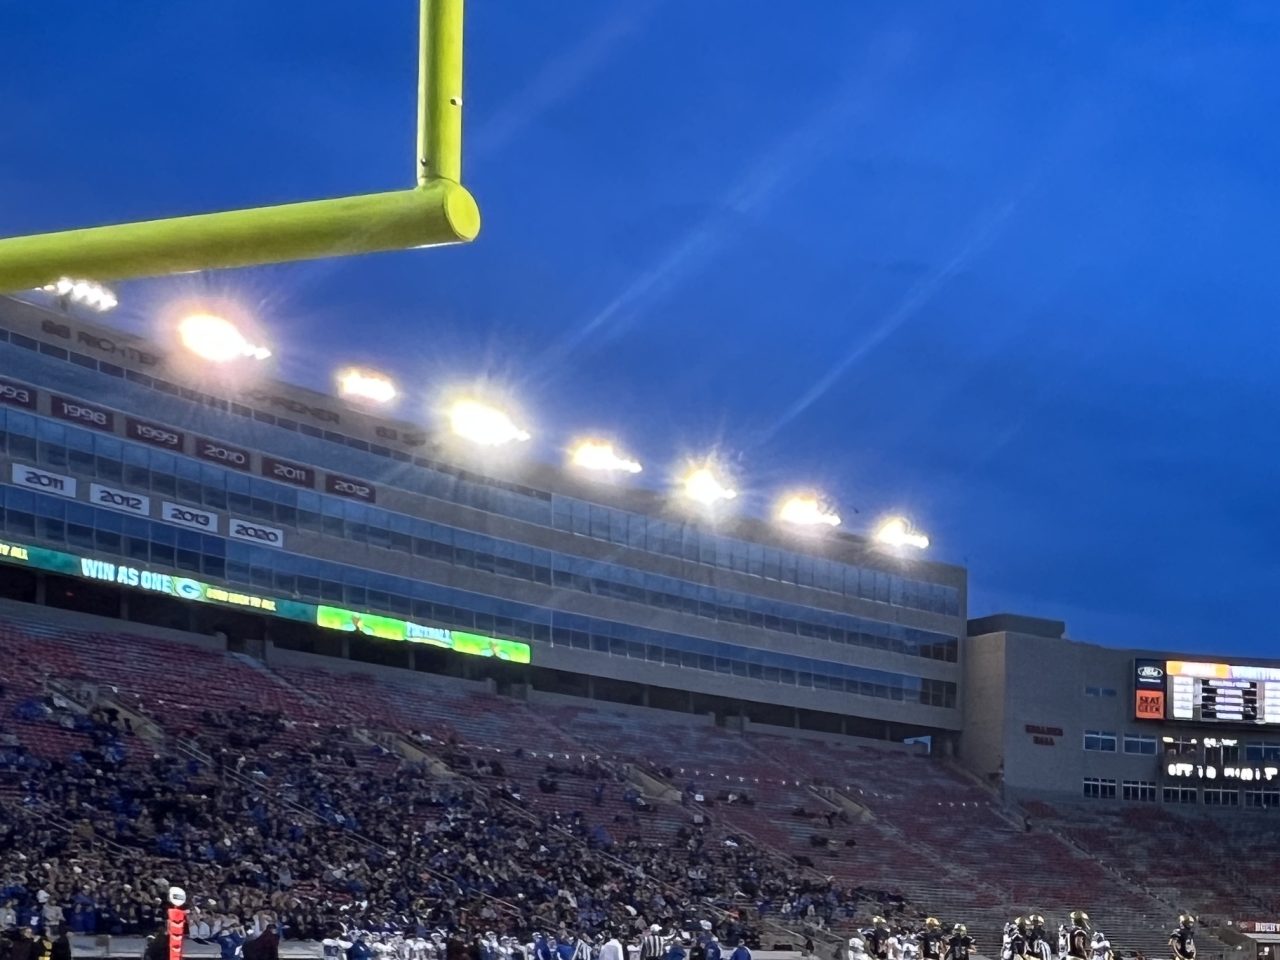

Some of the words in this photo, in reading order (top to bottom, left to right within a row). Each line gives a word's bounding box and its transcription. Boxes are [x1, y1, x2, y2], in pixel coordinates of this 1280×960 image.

[62, 402, 107, 425] 1998
[136, 424, 178, 445] 1999
[204, 444, 245, 464] 2010
[25, 470, 64, 491] 2011
[273, 463, 306, 481] 2011
[334, 479, 370, 498] 2012
[99, 490, 143, 510] 2012
[170, 507, 210, 526] 2013
[235, 523, 279, 543] 2020
[81, 558, 115, 581] WIN
[117, 566, 139, 586] AS
[140, 570, 173, 593] ONE
